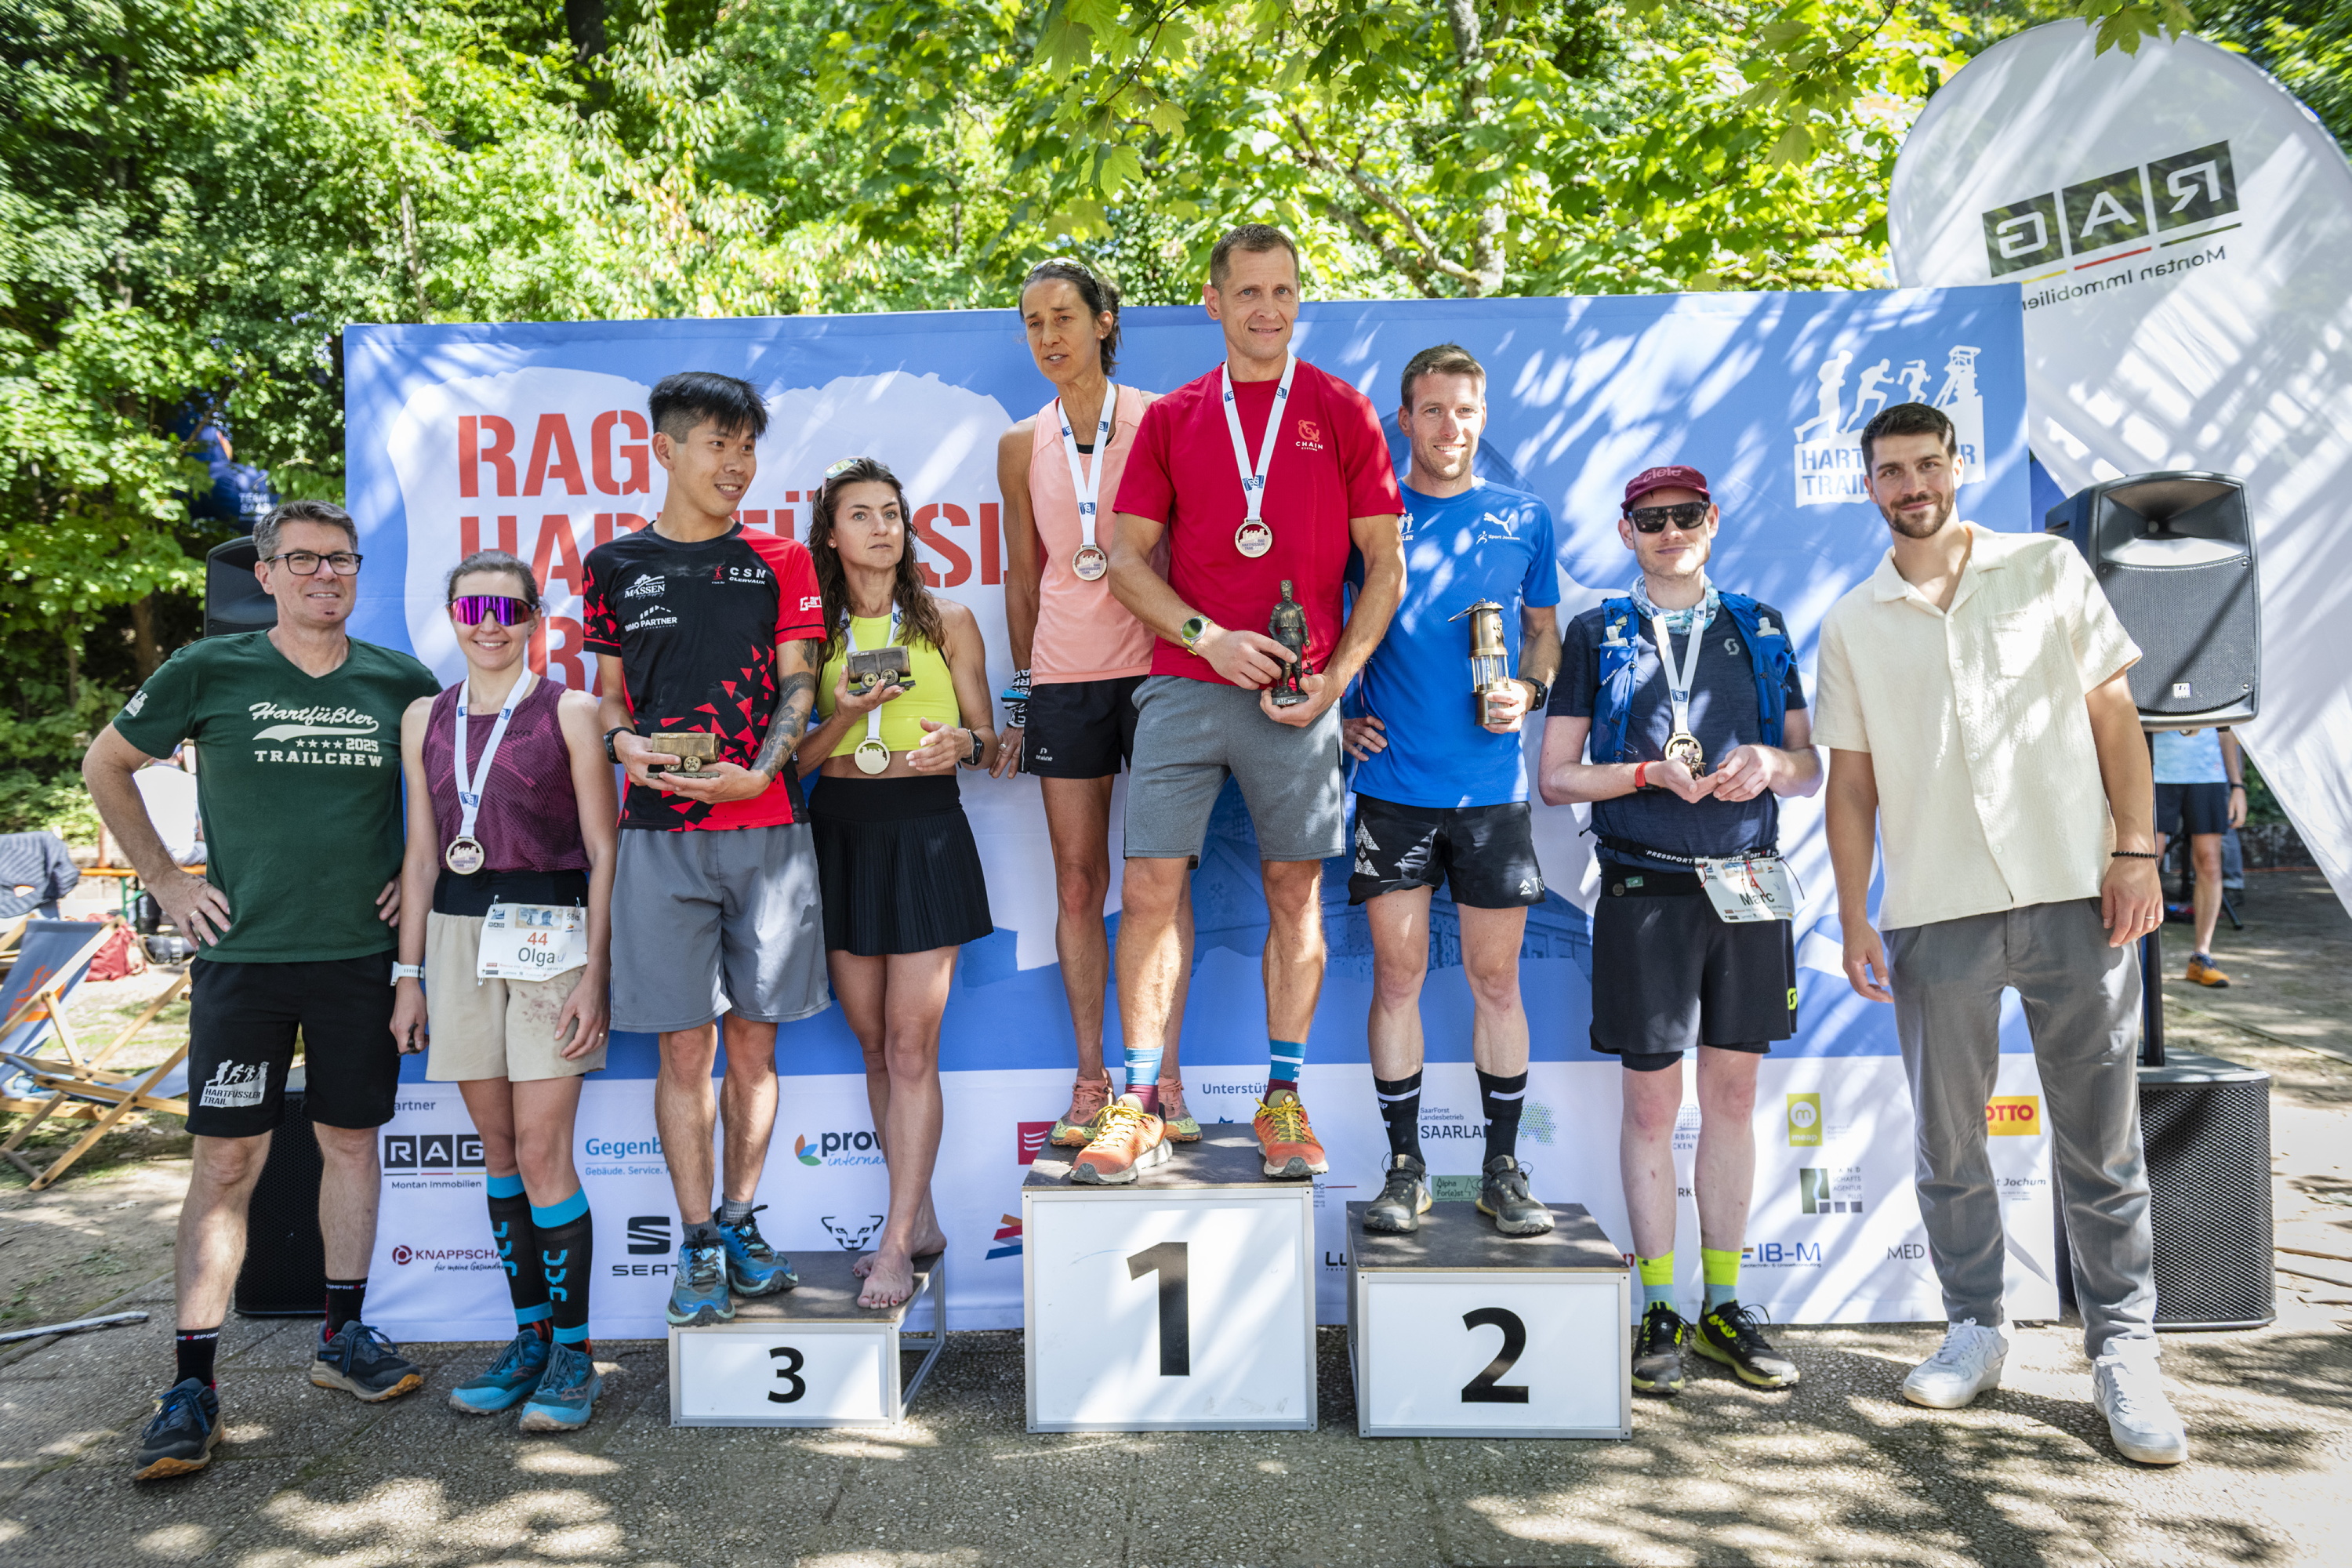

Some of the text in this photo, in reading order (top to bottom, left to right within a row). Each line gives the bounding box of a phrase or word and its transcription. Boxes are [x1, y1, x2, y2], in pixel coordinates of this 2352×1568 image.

[458, 410, 650, 498] RAG
[729, 576, 766, 585] CLERVAUX
[624, 584, 666, 599] MASSEN
[640, 617, 677, 628] PARTNER
[249, 702, 379, 726] Hartfüßler
[345, 737, 379, 753] 2025
[254, 750, 383, 768] TRAILCREW
[1646, 850, 1693, 864] PRESSPORT
[1739, 892, 1775, 906] Marc
[527, 931, 548, 946] 44
[518, 947, 555, 967] Olga
[205, 1087, 261, 1098] HARTFÜSSLER
[204, 1096, 227, 1105] TRAIL
[1421, 1125, 1486, 1138] SAARLA
[1791, 1134, 1818, 1142] meap
[390, 1141, 484, 1161] RAG
[585, 1167, 625, 1175] Gebäude.
[628, 1166, 662, 1174] Service.
[1436, 1178, 1457, 1189] Alpha
[2003, 1178, 2046, 1187] Jochum
[1887, 1244, 1926, 1260] MED
[1127, 1241, 1191, 1377] 1
[1461, 1307, 1530, 1404] 2
[767, 1346, 806, 1403] 3
